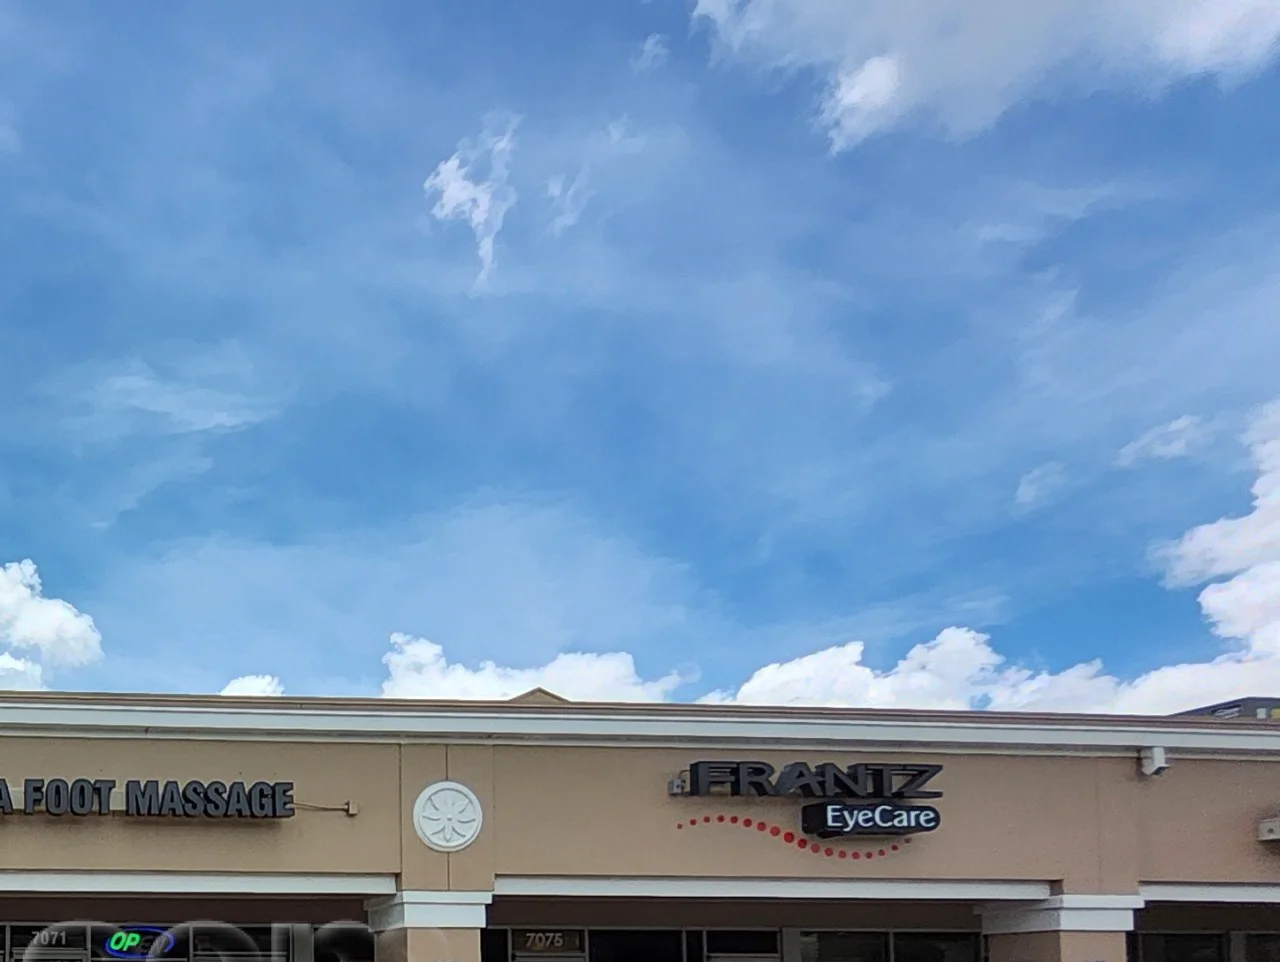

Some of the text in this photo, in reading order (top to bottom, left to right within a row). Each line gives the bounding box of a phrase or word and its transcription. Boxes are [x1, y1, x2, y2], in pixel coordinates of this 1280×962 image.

[690, 761, 943, 798] FRANTZ
[23, 778, 116, 816] FOOT
[125, 780, 295, 818] MASSAGE
[826, 805, 938, 832] EyeCare
[31, 931, 67, 945] 7071
[526, 932, 563, 947] 7075
